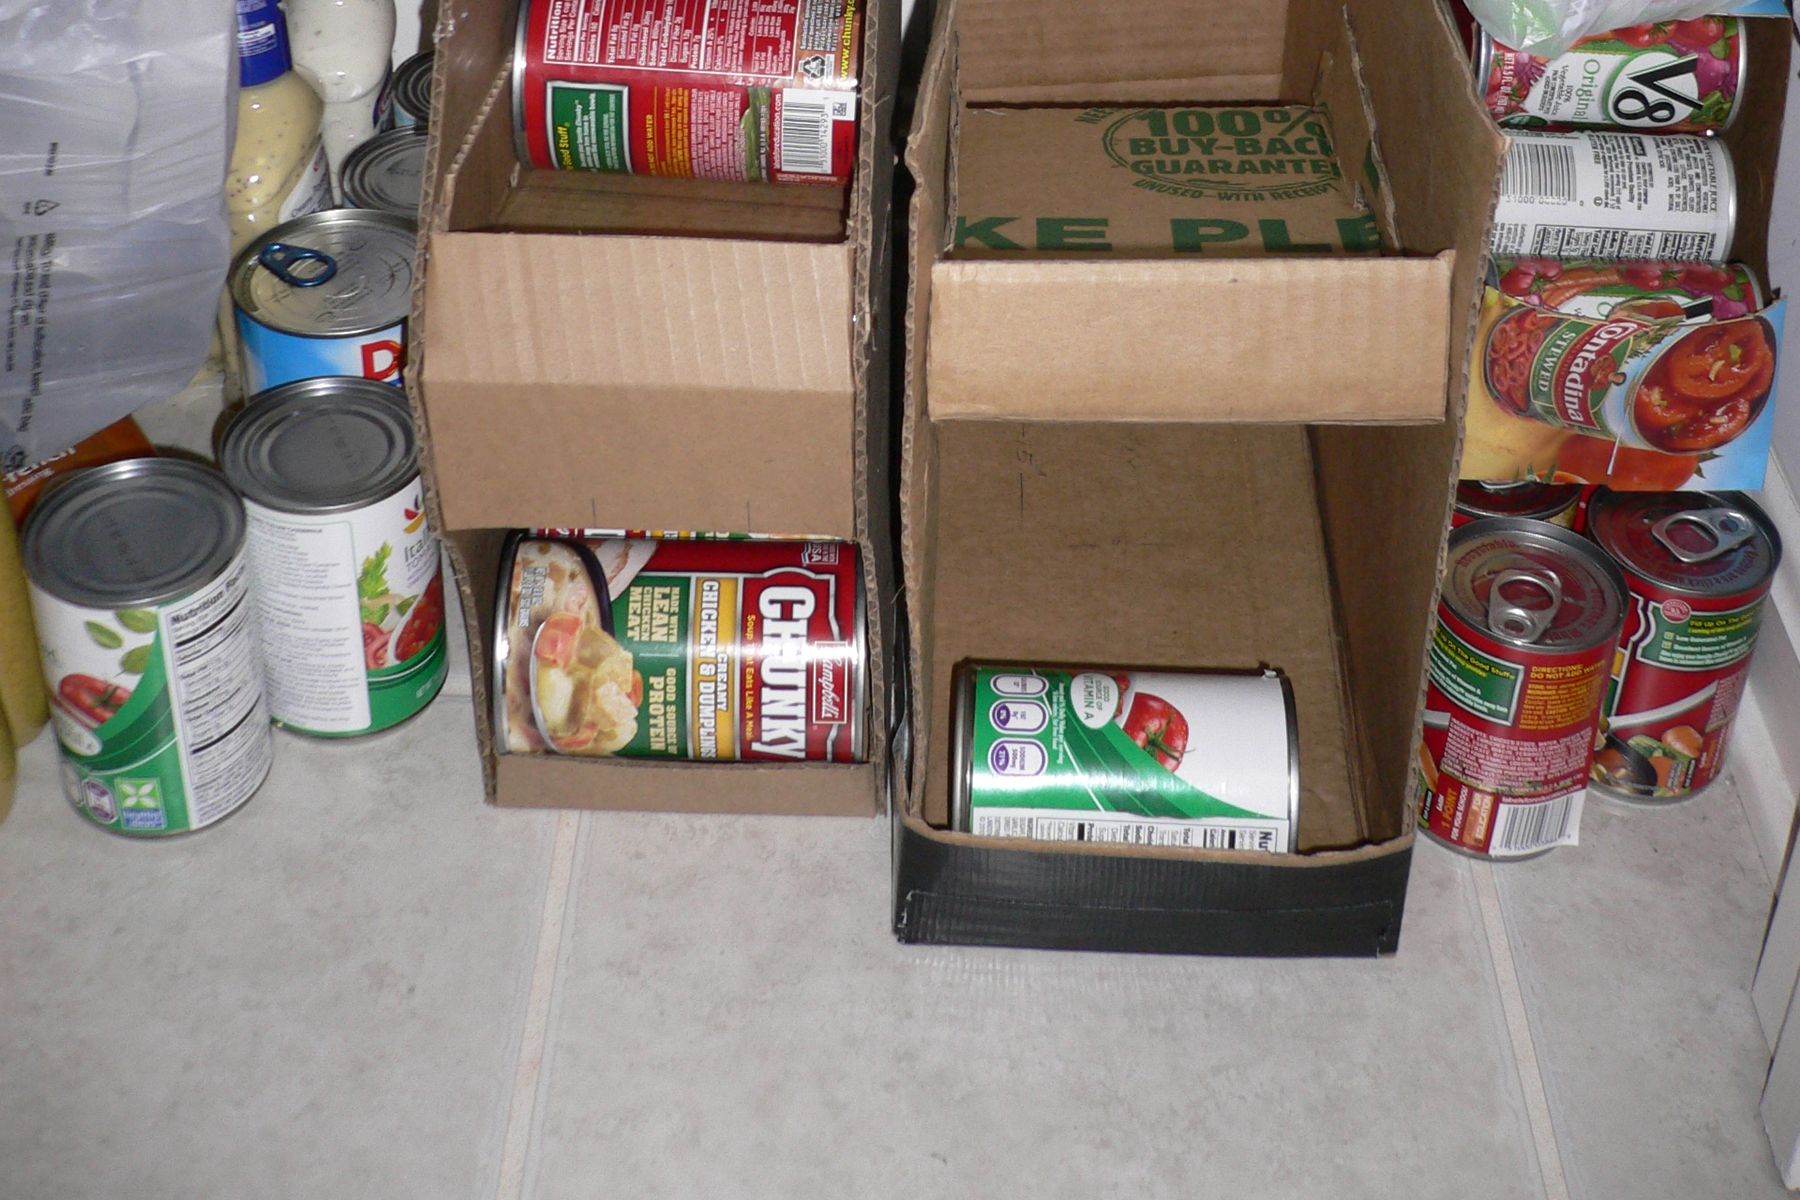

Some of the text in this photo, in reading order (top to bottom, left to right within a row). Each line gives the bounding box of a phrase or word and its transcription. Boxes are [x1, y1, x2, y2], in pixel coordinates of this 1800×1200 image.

[547, 2, 563, 59] Nutrition
[567, 19, 575, 30] Per
[661, 6, 673, 48] Carbohydrate
[556, 34, 567, 60] Serving
[565, 31, 574, 61] Servings
[587, 34, 597, 63] Calories
[608, 33, 618, 63] Total Fat
[639, 26, 649, 66] Cholesterol
[649, 40, 658, 66] Sodium
[691, 43, 700, 69] Protein
[715, 46, 724, 70] Calcium
[1555, 65, 1569, 101] Vegetable
[1572, 59, 1601, 121] Original
[1612, 54, 1704, 123] V8
[557, 127, 569, 148] Stuff
[646, 114, 654, 138] WATER
[1537, 331, 1577, 391] STEWED
[1563, 323, 1637, 421] Contadina
[171, 590, 224, 625] Nutrition
[627, 586, 643, 640] MEAT
[641, 586, 653, 641] CHICKEN
[651, 586, 670, 641] LEAN
[668, 586, 680, 643] MADE WITH
[745, 615, 756, 640] Soup
[666, 668, 676, 701] GOOD
[698, 581, 719, 759] CHICKEN & DUMPLINGS
[716, 653, 728, 711] CREAMY
[745, 668, 754, 689] Eats
[751, 586, 816, 759] CHUNKY
[1470, 657, 1490, 671] Good
[1490, 667, 1511, 678] Stuff
[648, 676, 666, 751] PROTEIN
[745, 691, 754, 710] Like
[1084, 712, 1094, 720] A
[666, 705, 676, 744] SOURCE
